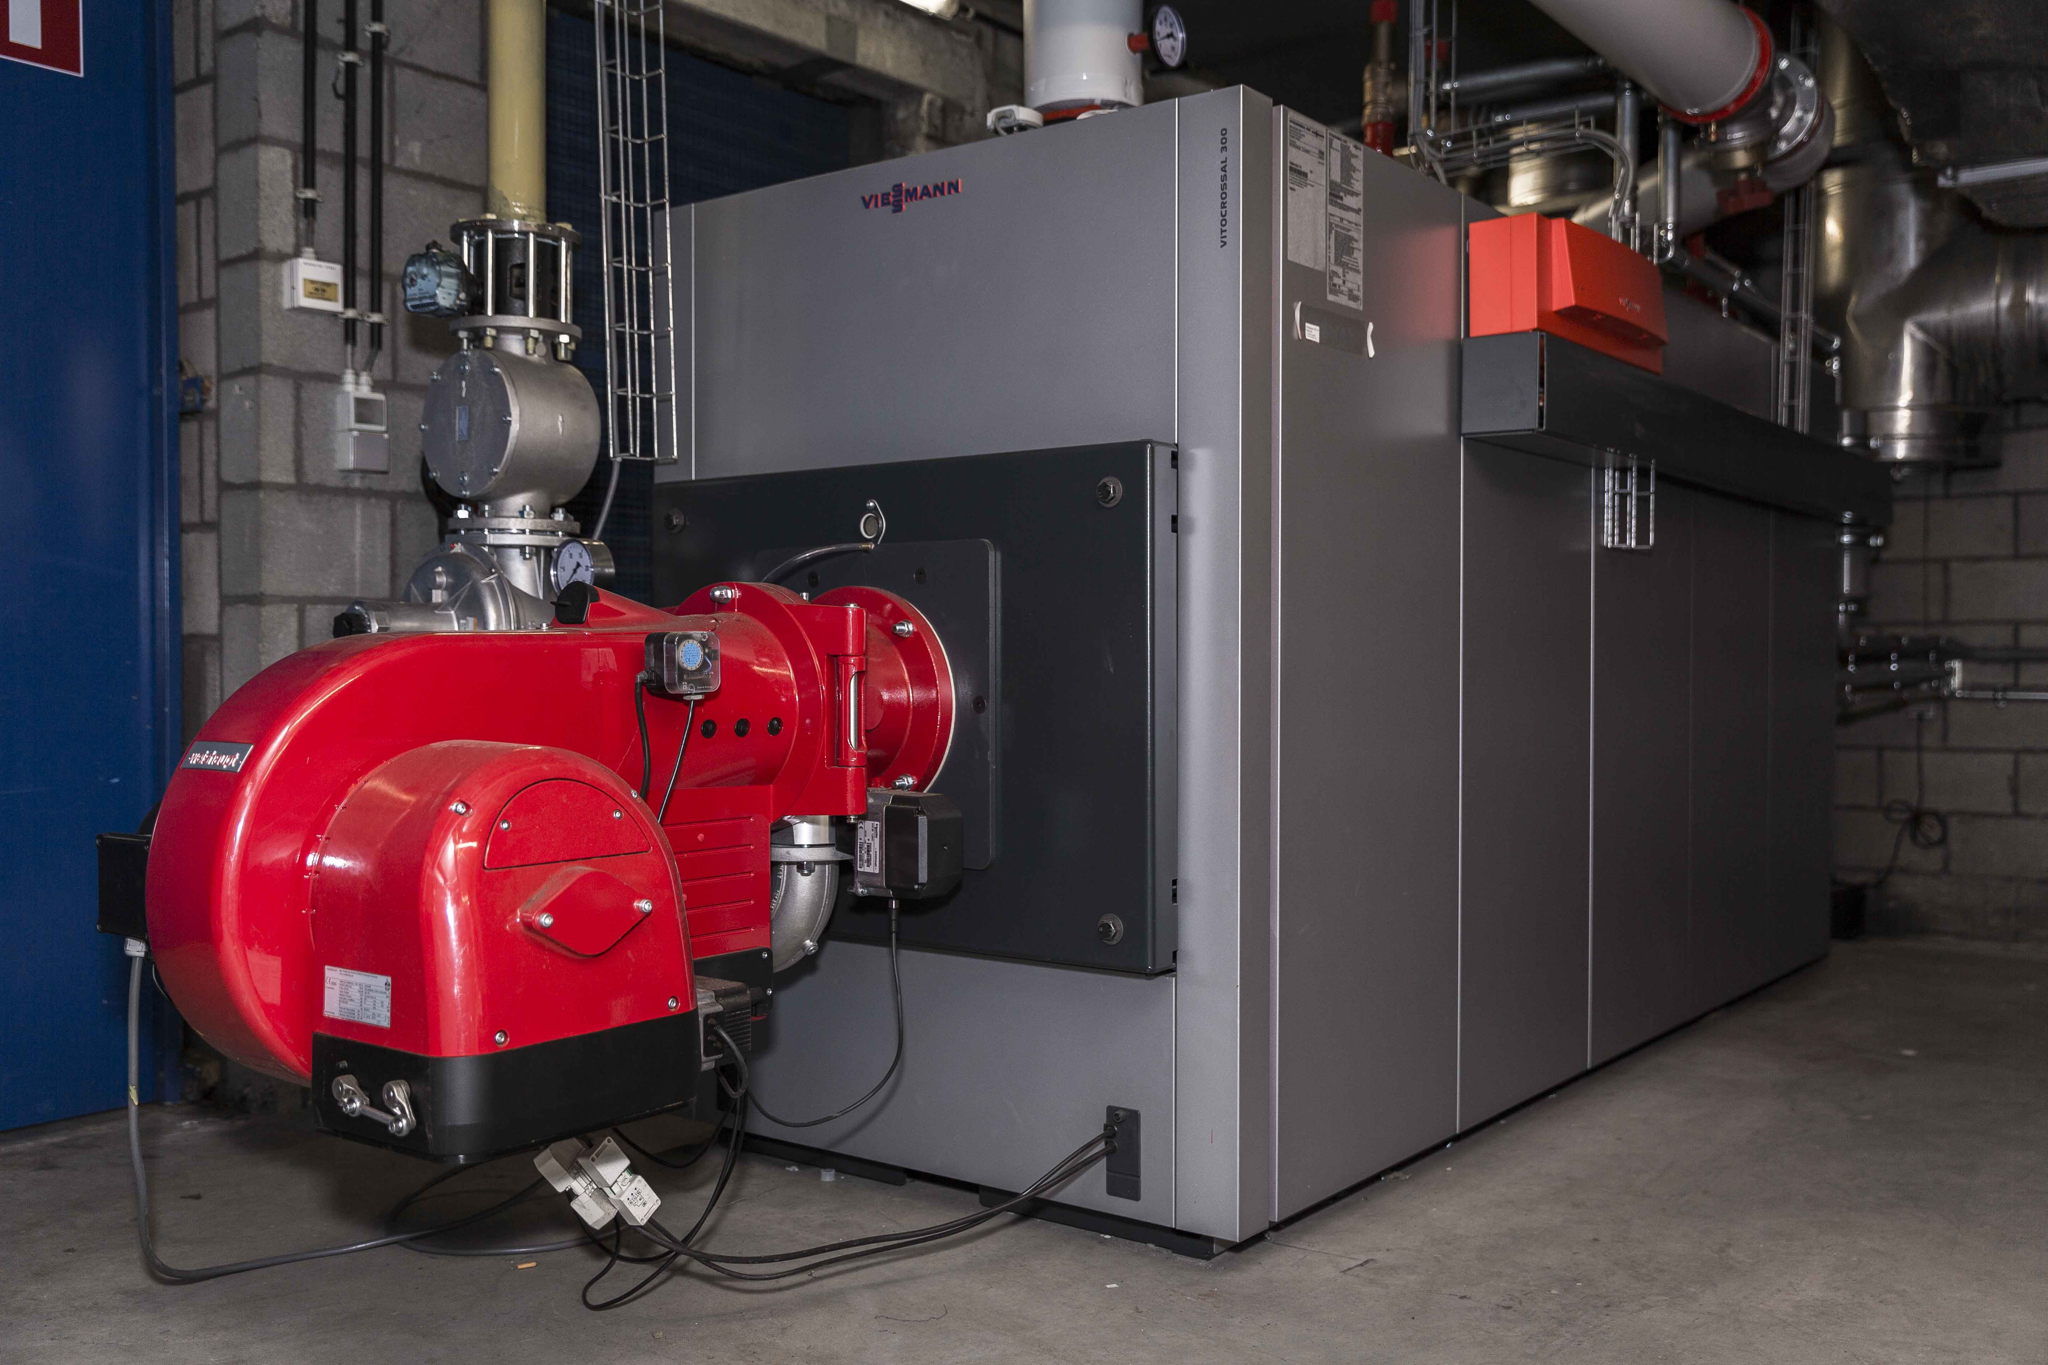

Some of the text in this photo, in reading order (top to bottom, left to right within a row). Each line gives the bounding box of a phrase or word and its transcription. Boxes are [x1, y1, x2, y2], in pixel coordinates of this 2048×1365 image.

[861, 179, 963, 214] VIESSMANN
[1220, 127, 1228, 248] VITOCROSSAL 300
